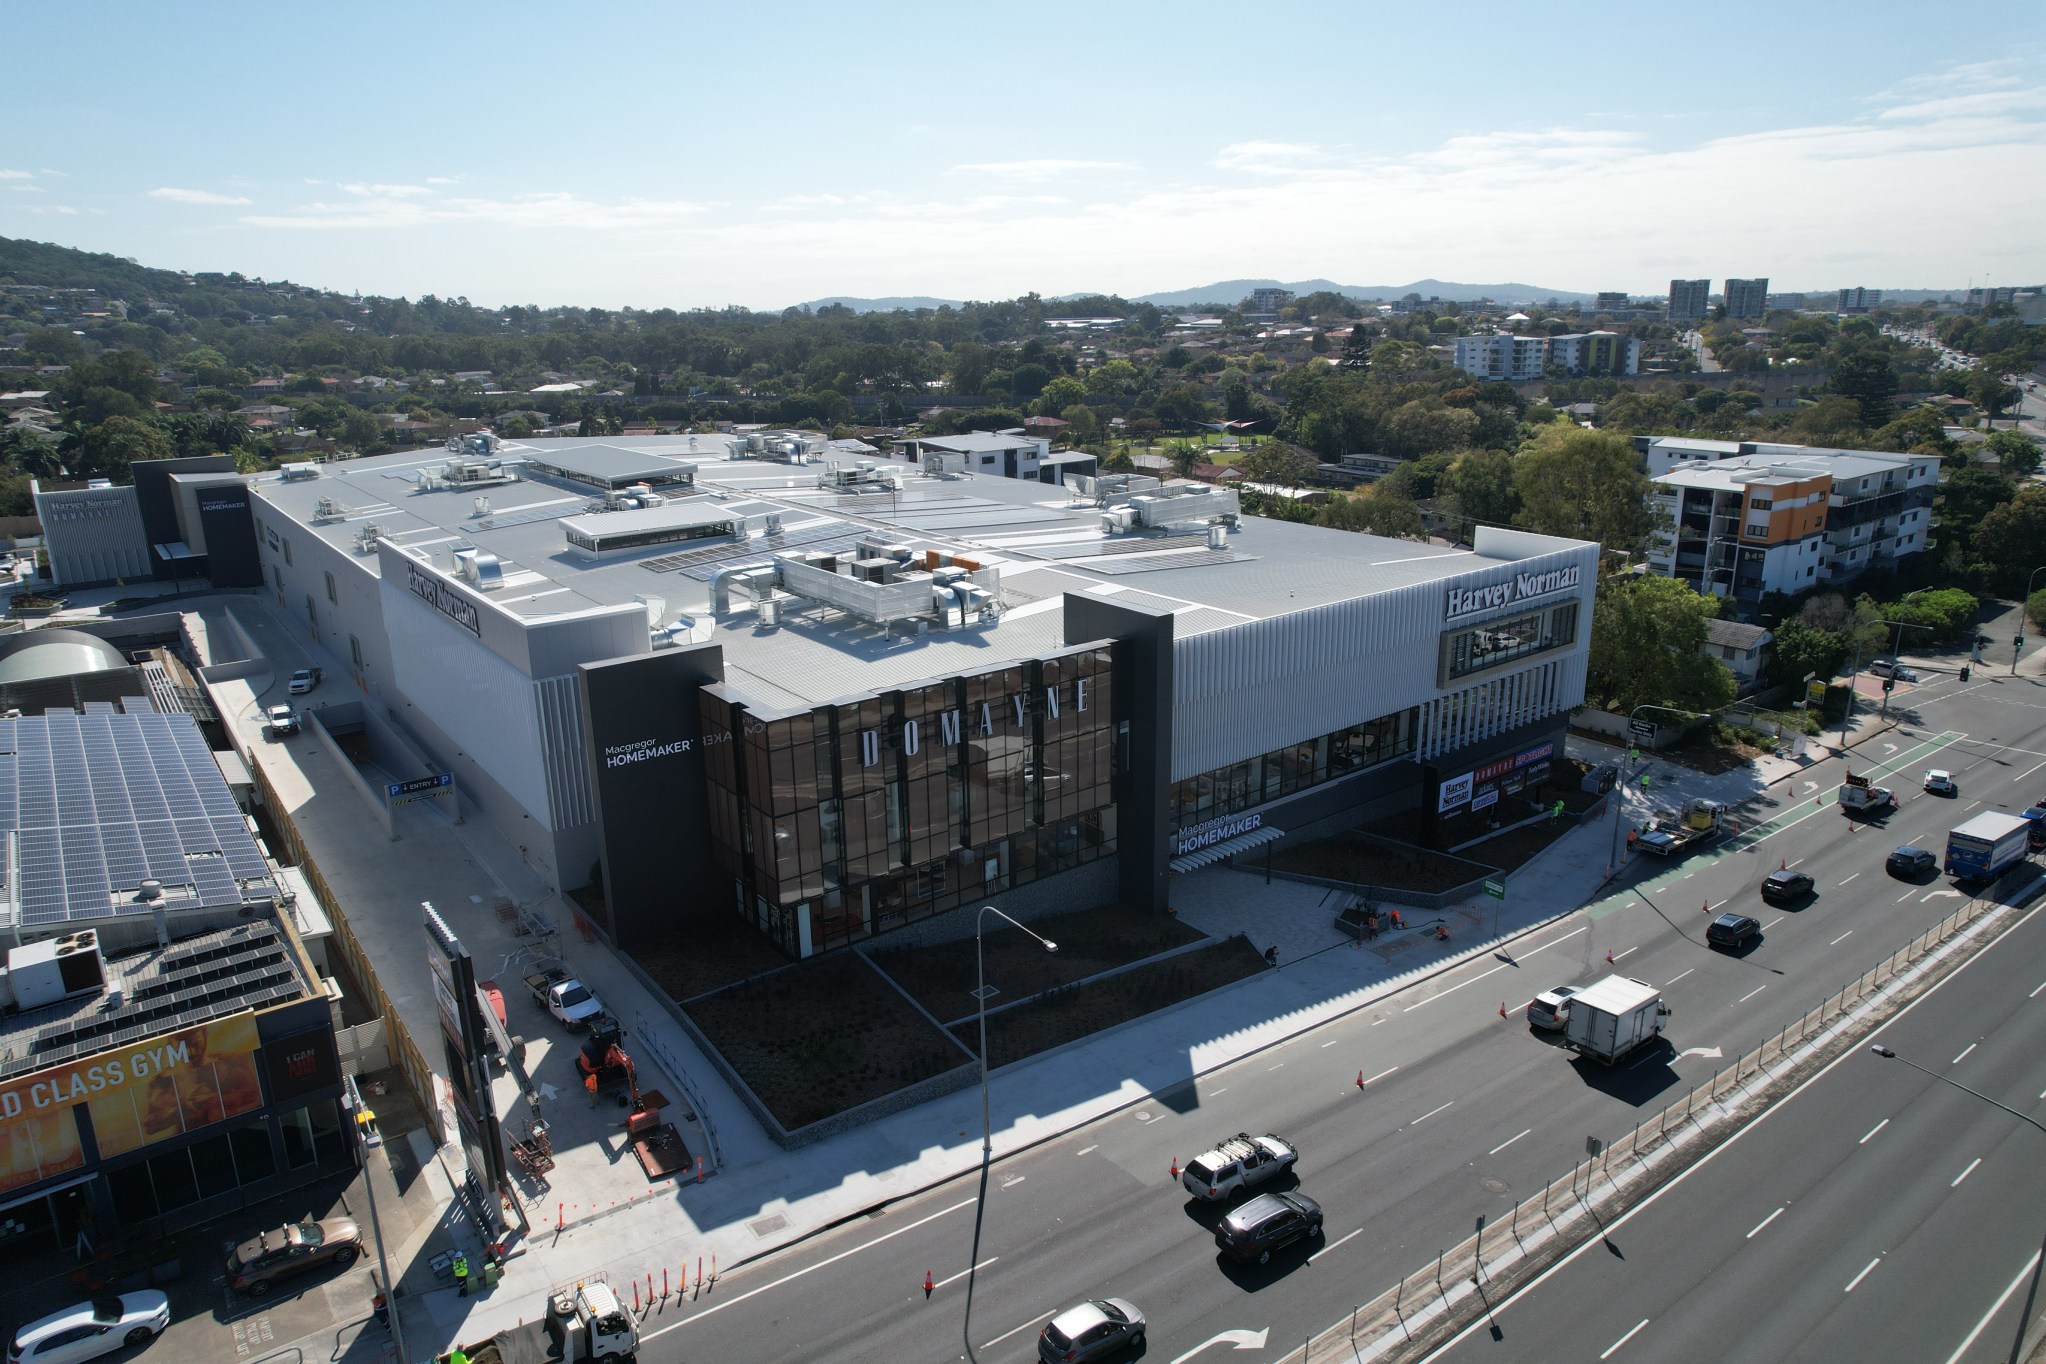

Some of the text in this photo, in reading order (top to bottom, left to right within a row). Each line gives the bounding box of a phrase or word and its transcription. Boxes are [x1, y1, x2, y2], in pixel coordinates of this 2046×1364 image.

[51, 499, 123, 510] Harvey Norman
[202, 502, 246, 511] HOMEMAKER
[1446, 565, 1580, 617] Harvey Norman
[862, 679, 1088, 768] DOMAYNE
[605, 738, 656, 755] Macgregor
[606, 740, 690, 768] HOMEMAKER
[1515, 744, 1553, 766] SPOTLIGHT
[391, 775, 449, 795] P ENTRY P
[1445, 779, 1469, 793] Harvey
[1442, 790, 1469, 806] Norman
[1178, 814, 1261, 855] HOMEMAKER
[1179, 814, 1229, 836] Macgregor
[292, 1048, 315, 1061] CAN
[0, 1039, 190, 1121] D CLASS GYM
